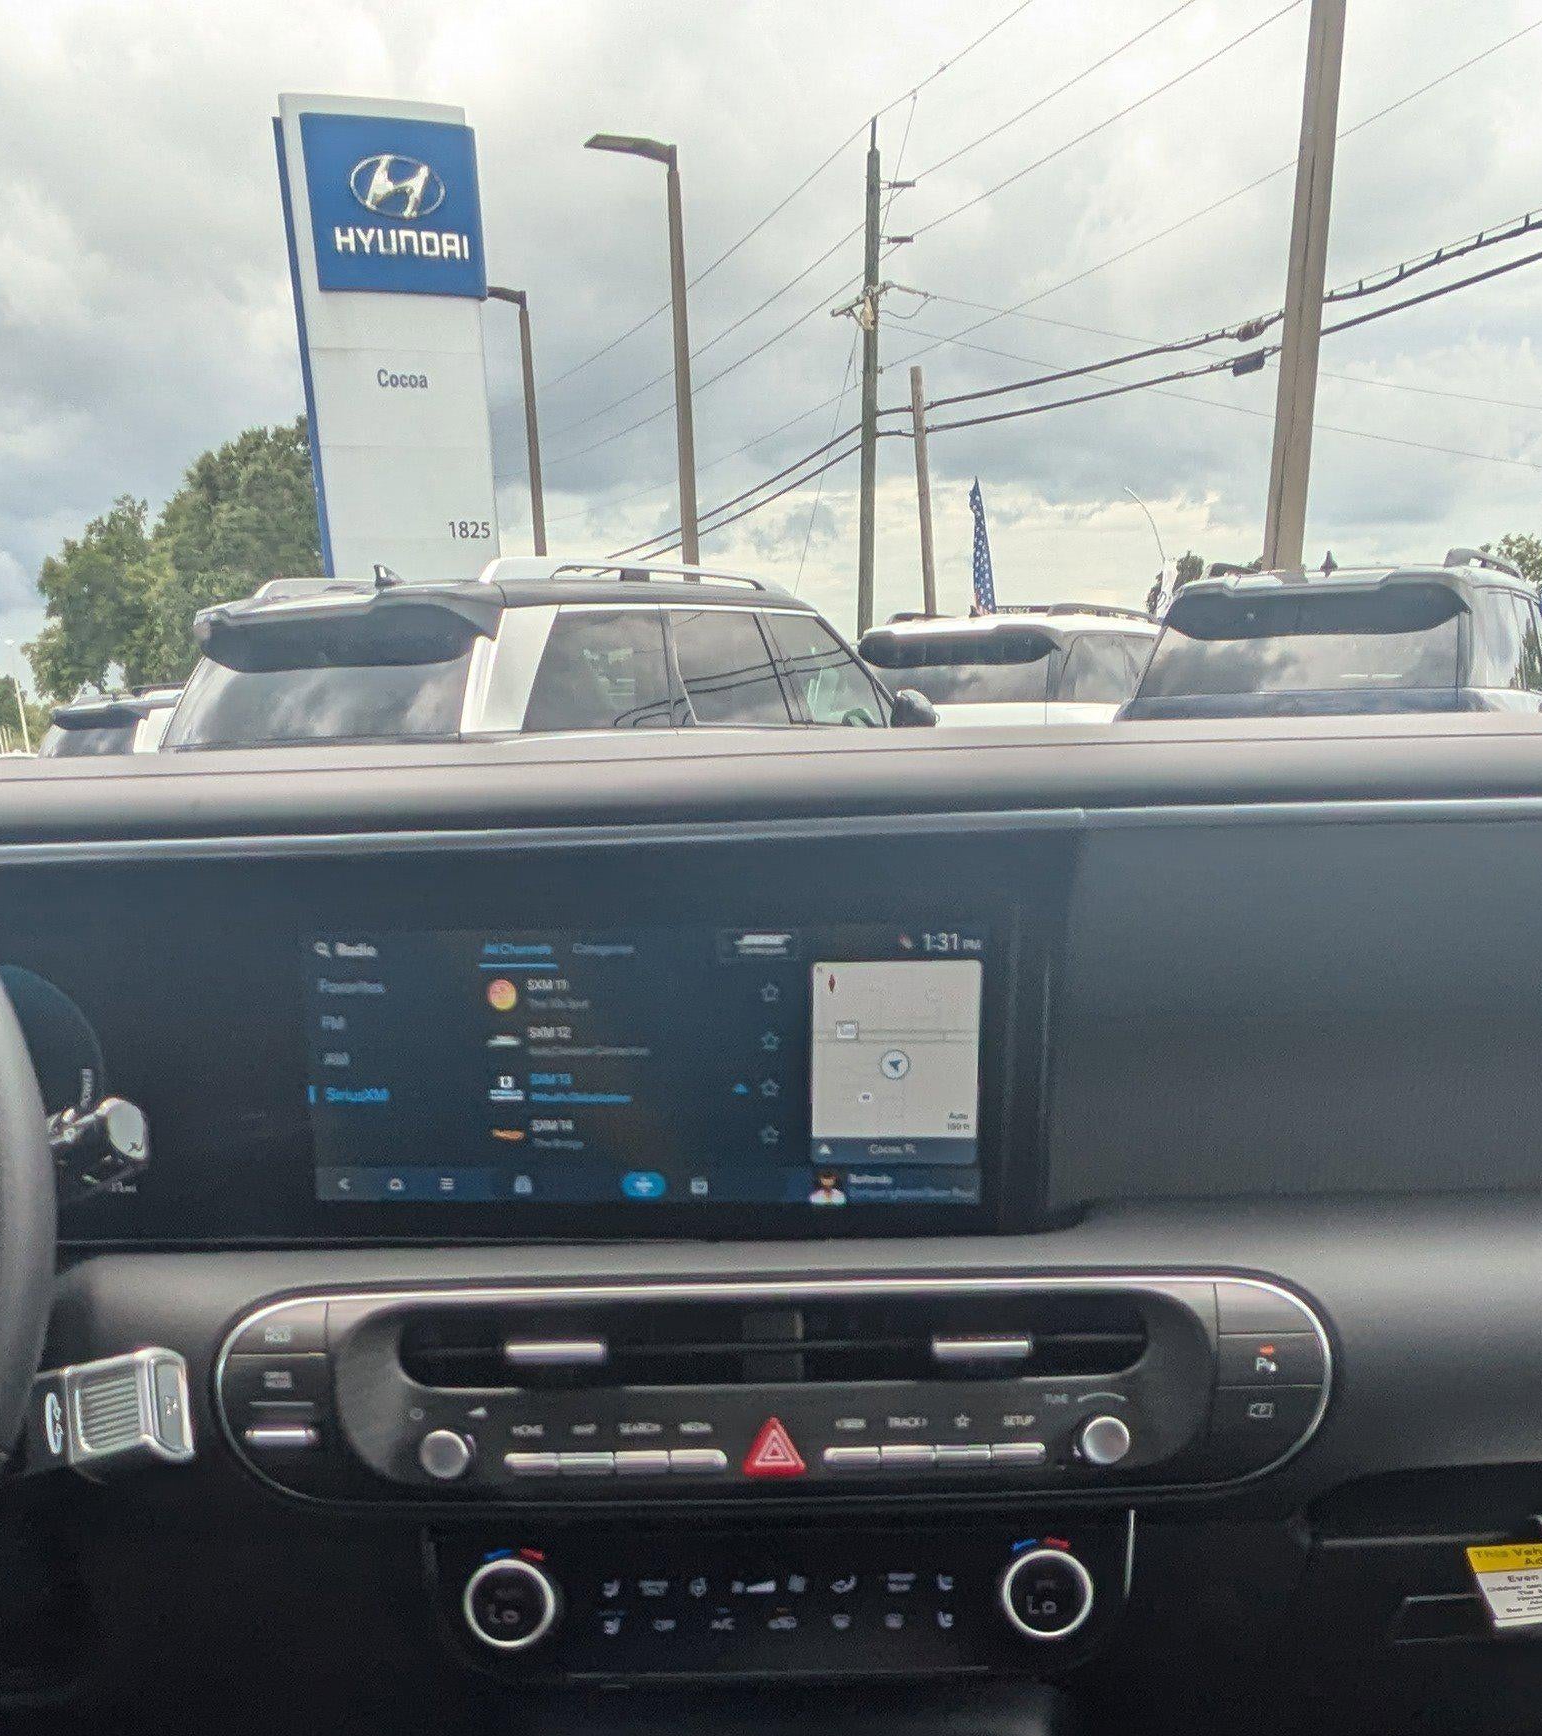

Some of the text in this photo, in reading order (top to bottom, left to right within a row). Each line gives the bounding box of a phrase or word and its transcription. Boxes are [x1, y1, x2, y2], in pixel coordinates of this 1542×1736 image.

[333, 225, 471, 262] HYUNDAI
[376, 368, 429, 390] Cocoa
[447, 521, 492, 540] 1825
[923, 932, 959, 951] 1:31
[1003, 1414, 1035, 1427] SETUP
